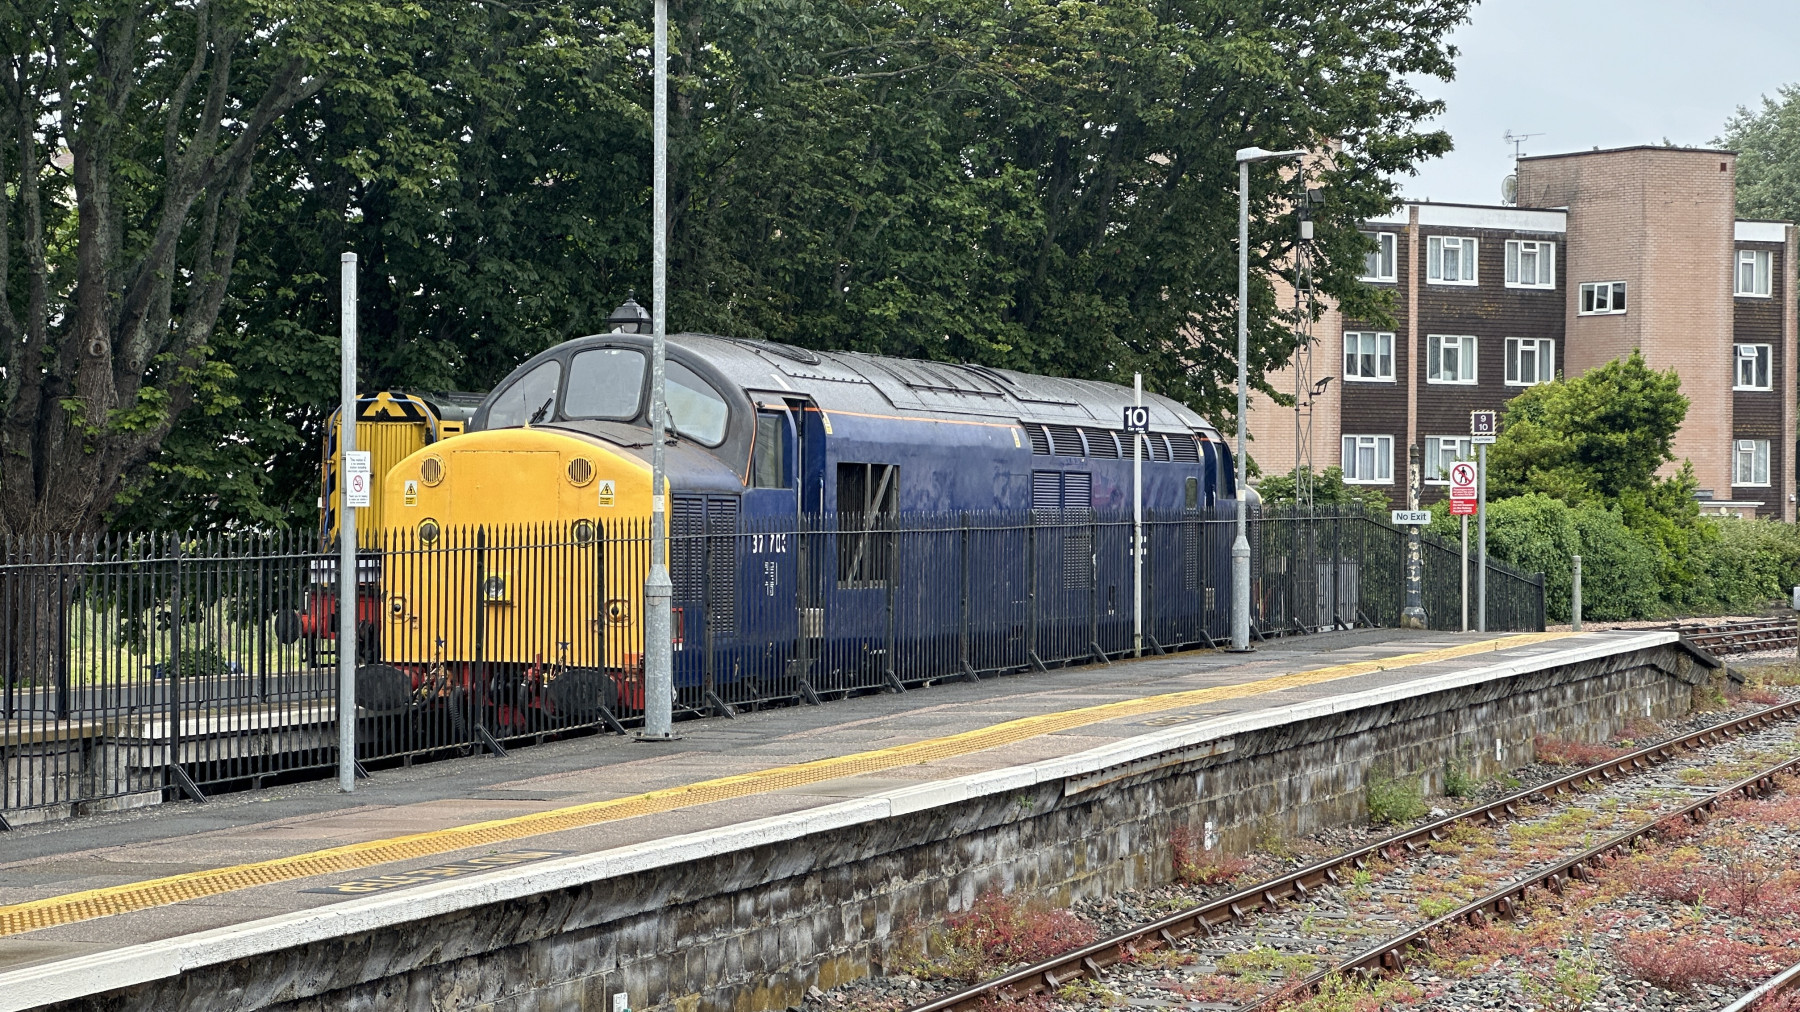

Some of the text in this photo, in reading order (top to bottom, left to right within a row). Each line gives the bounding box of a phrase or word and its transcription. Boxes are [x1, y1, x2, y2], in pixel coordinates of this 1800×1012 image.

[1126, 408, 1147, 426] 10
[1479, 423, 1489, 431] 10
[1396, 512, 1427, 521] No Exit
[752, 534, 764, 553] 37
